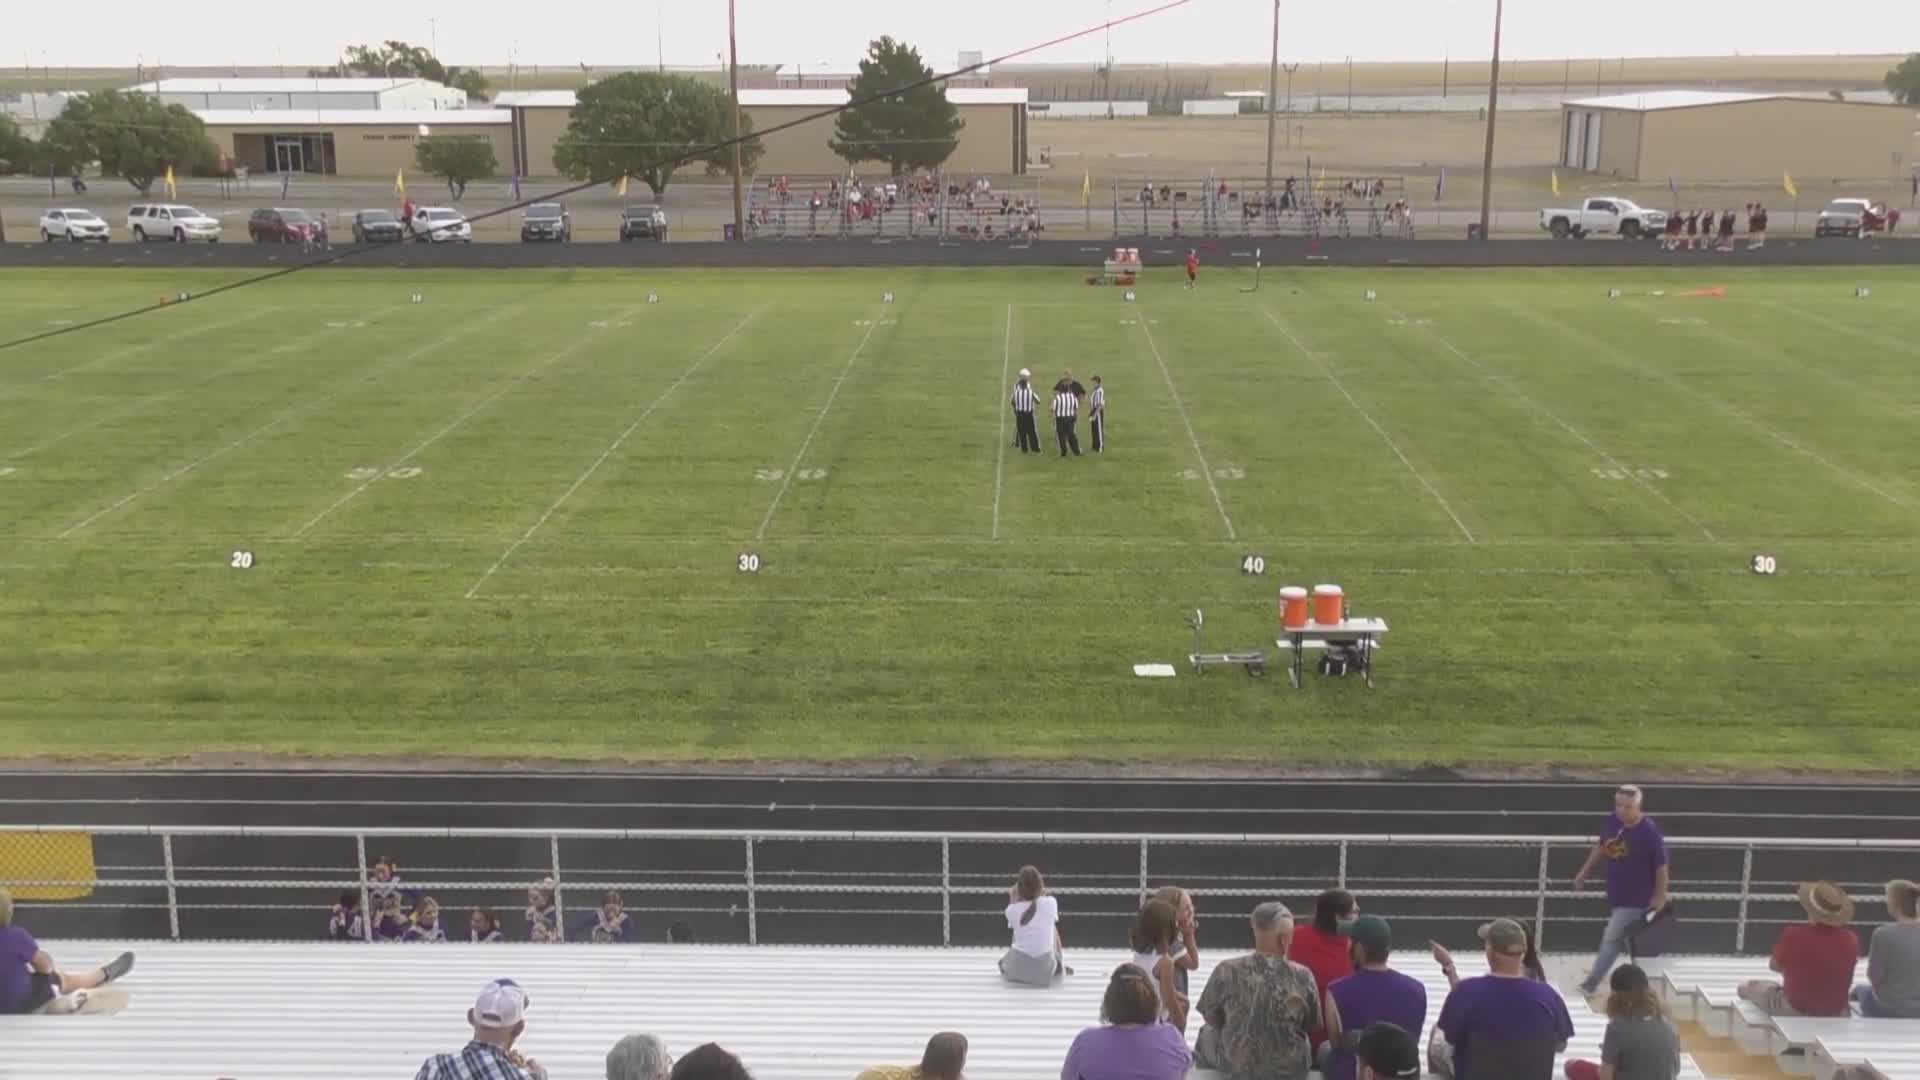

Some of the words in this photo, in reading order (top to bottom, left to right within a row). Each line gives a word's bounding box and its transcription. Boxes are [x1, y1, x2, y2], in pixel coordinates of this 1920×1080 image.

[231, 550, 253, 568] 20
[738, 554, 759, 571] 30
[1243, 556, 1264, 573] 40
[1754, 555, 1776, 573] 30
